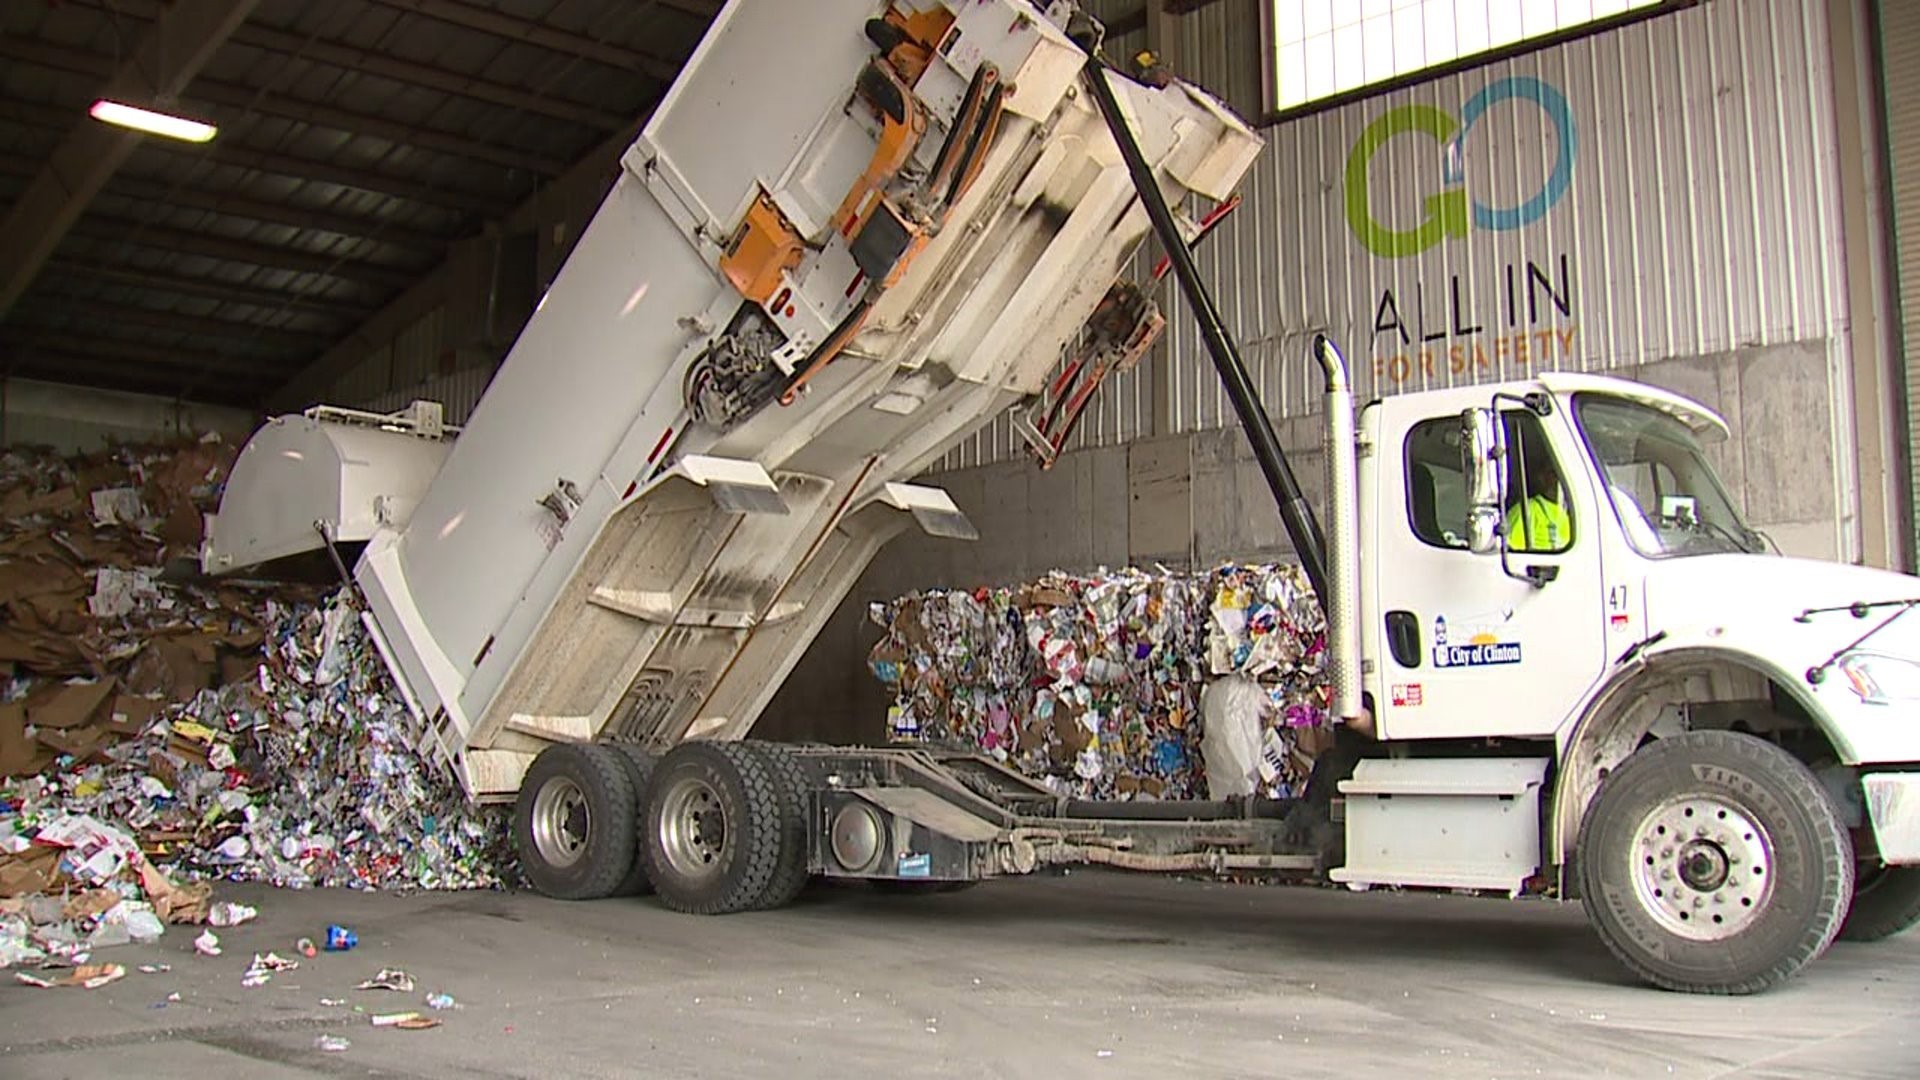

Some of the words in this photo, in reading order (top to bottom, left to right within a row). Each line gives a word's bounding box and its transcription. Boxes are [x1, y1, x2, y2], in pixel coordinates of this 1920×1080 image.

[1344, 76, 1578, 259] GO
[1370, 275, 1483, 351] ALL
[1507, 254, 1571, 328] IN
[1371, 350, 1434, 387] FOR
[1449, 325, 1577, 375] SAFETY
[1609, 585, 1627, 610] 47
[1450, 646, 1470, 666] City
[1472, 645, 1483, 664] of
[1484, 642, 1520, 662] Clinton
